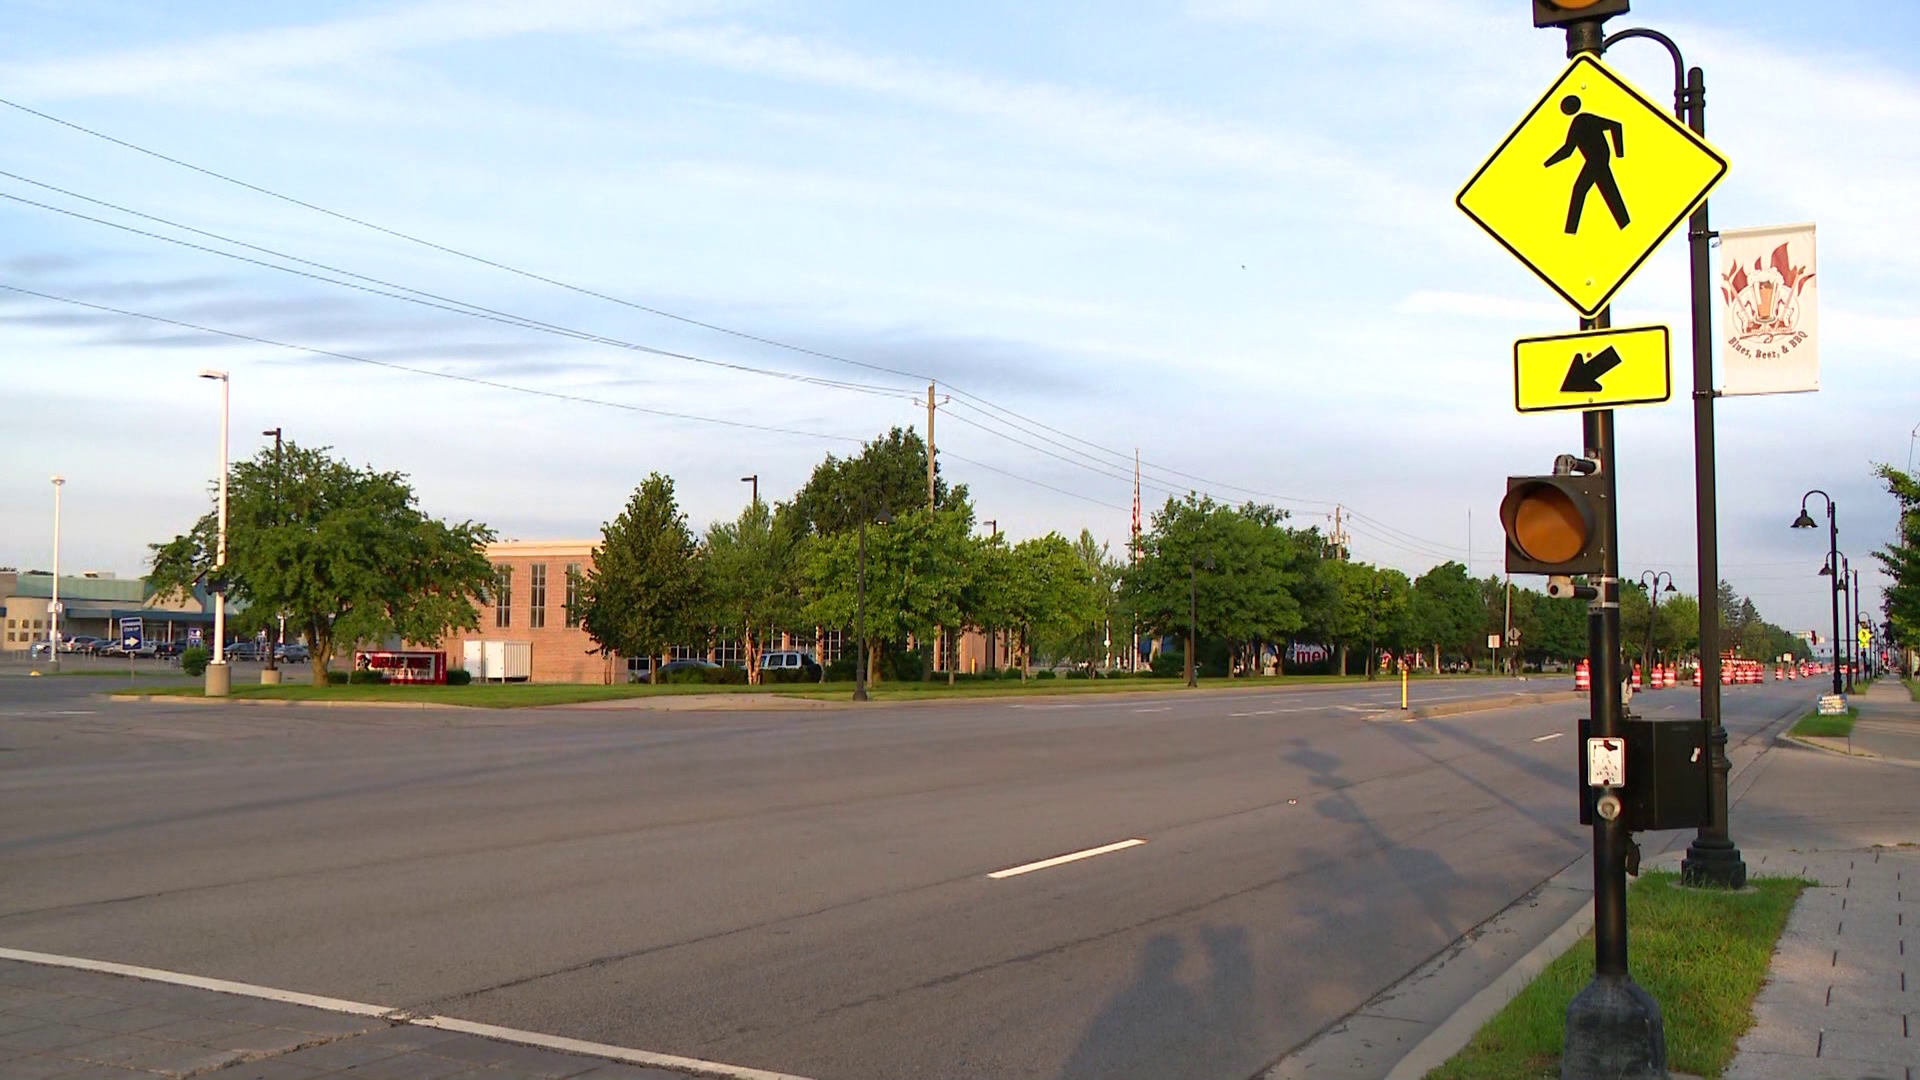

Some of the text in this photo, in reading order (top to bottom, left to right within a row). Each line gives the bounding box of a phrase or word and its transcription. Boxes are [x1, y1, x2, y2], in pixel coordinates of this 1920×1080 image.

[1728, 337, 1751, 359] Blues,
[1782, 345, 1789, 354] &
[1790, 331, 1808, 348] BBQ
